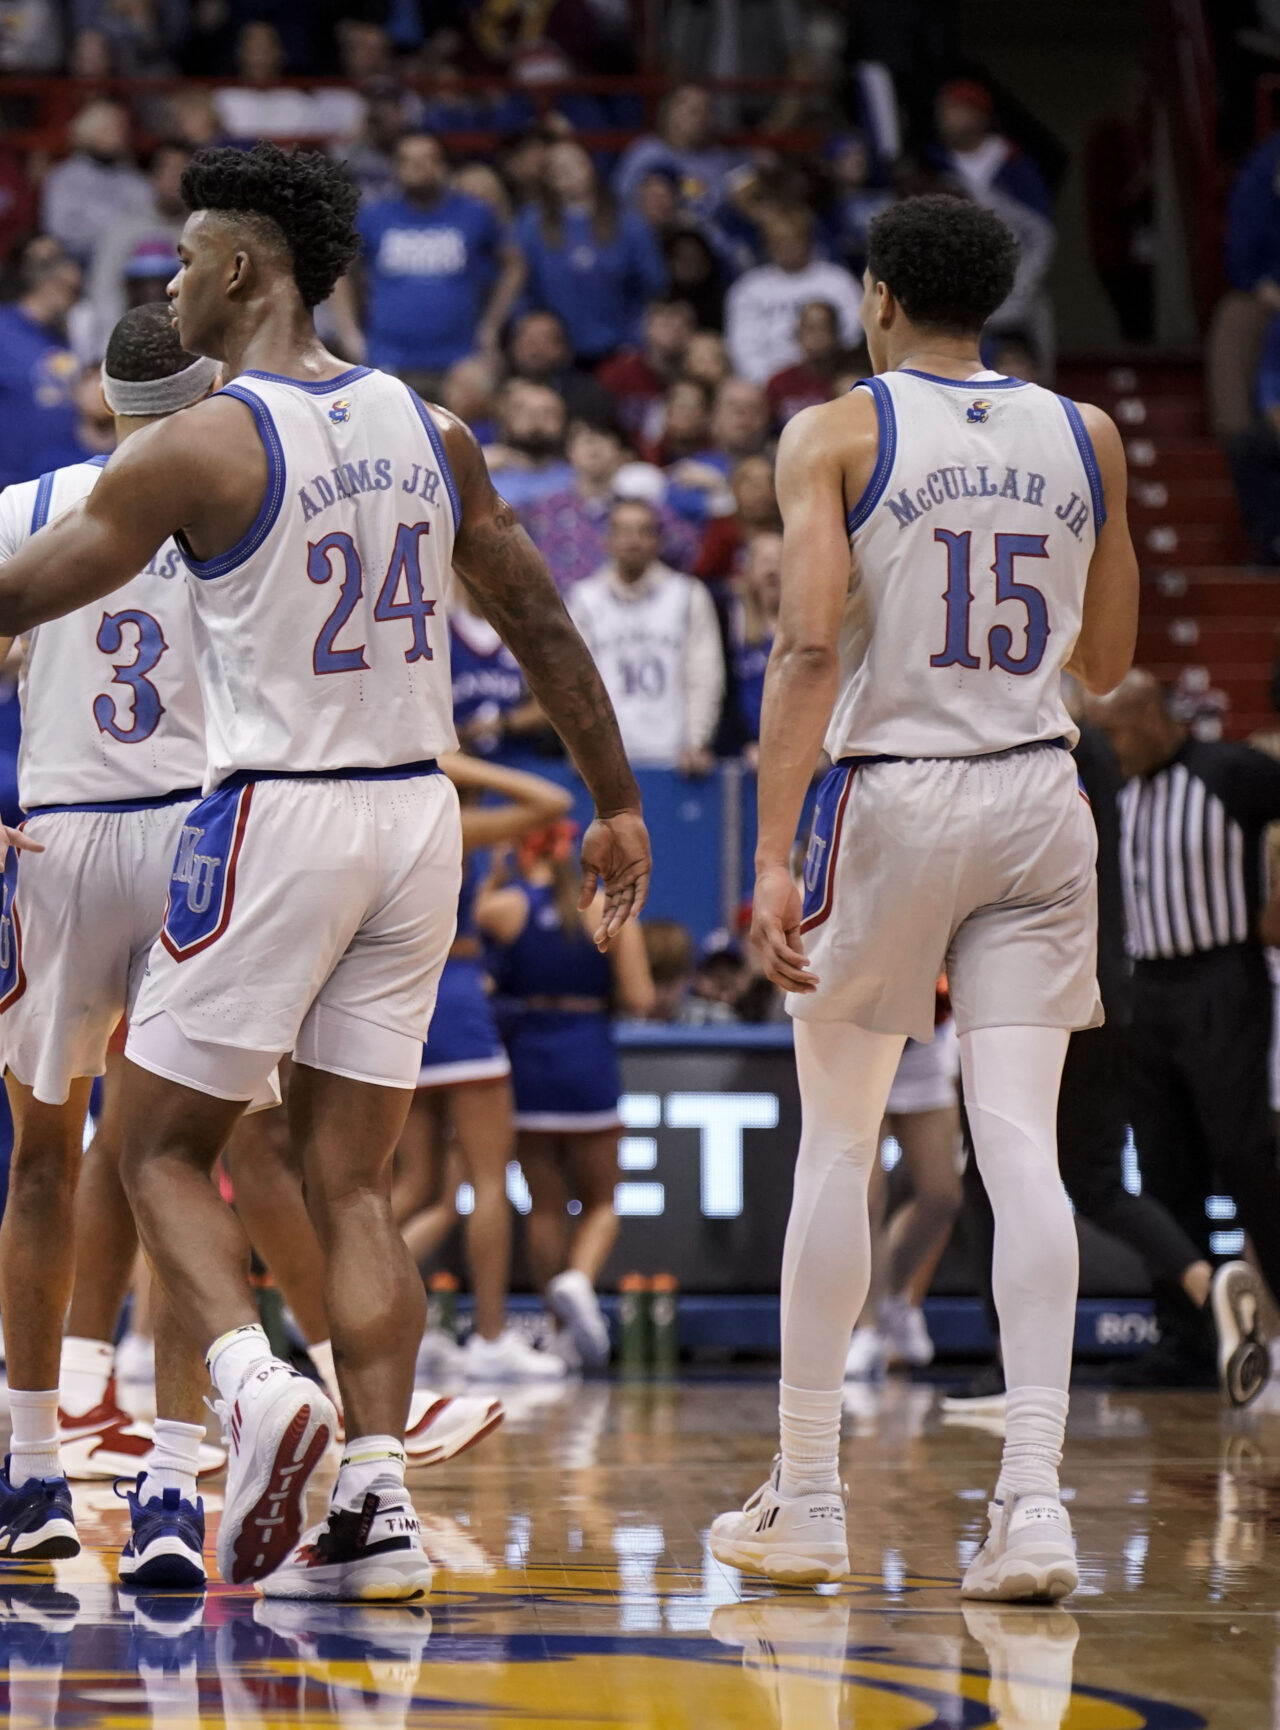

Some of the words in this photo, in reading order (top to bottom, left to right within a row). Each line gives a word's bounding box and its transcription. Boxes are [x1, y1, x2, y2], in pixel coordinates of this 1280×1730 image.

[298, 458, 393, 523] ADAMS
[307, 522, 437, 675] 24
[929, 528, 1051, 675] 15
[93, 609, 169, 744] 3
